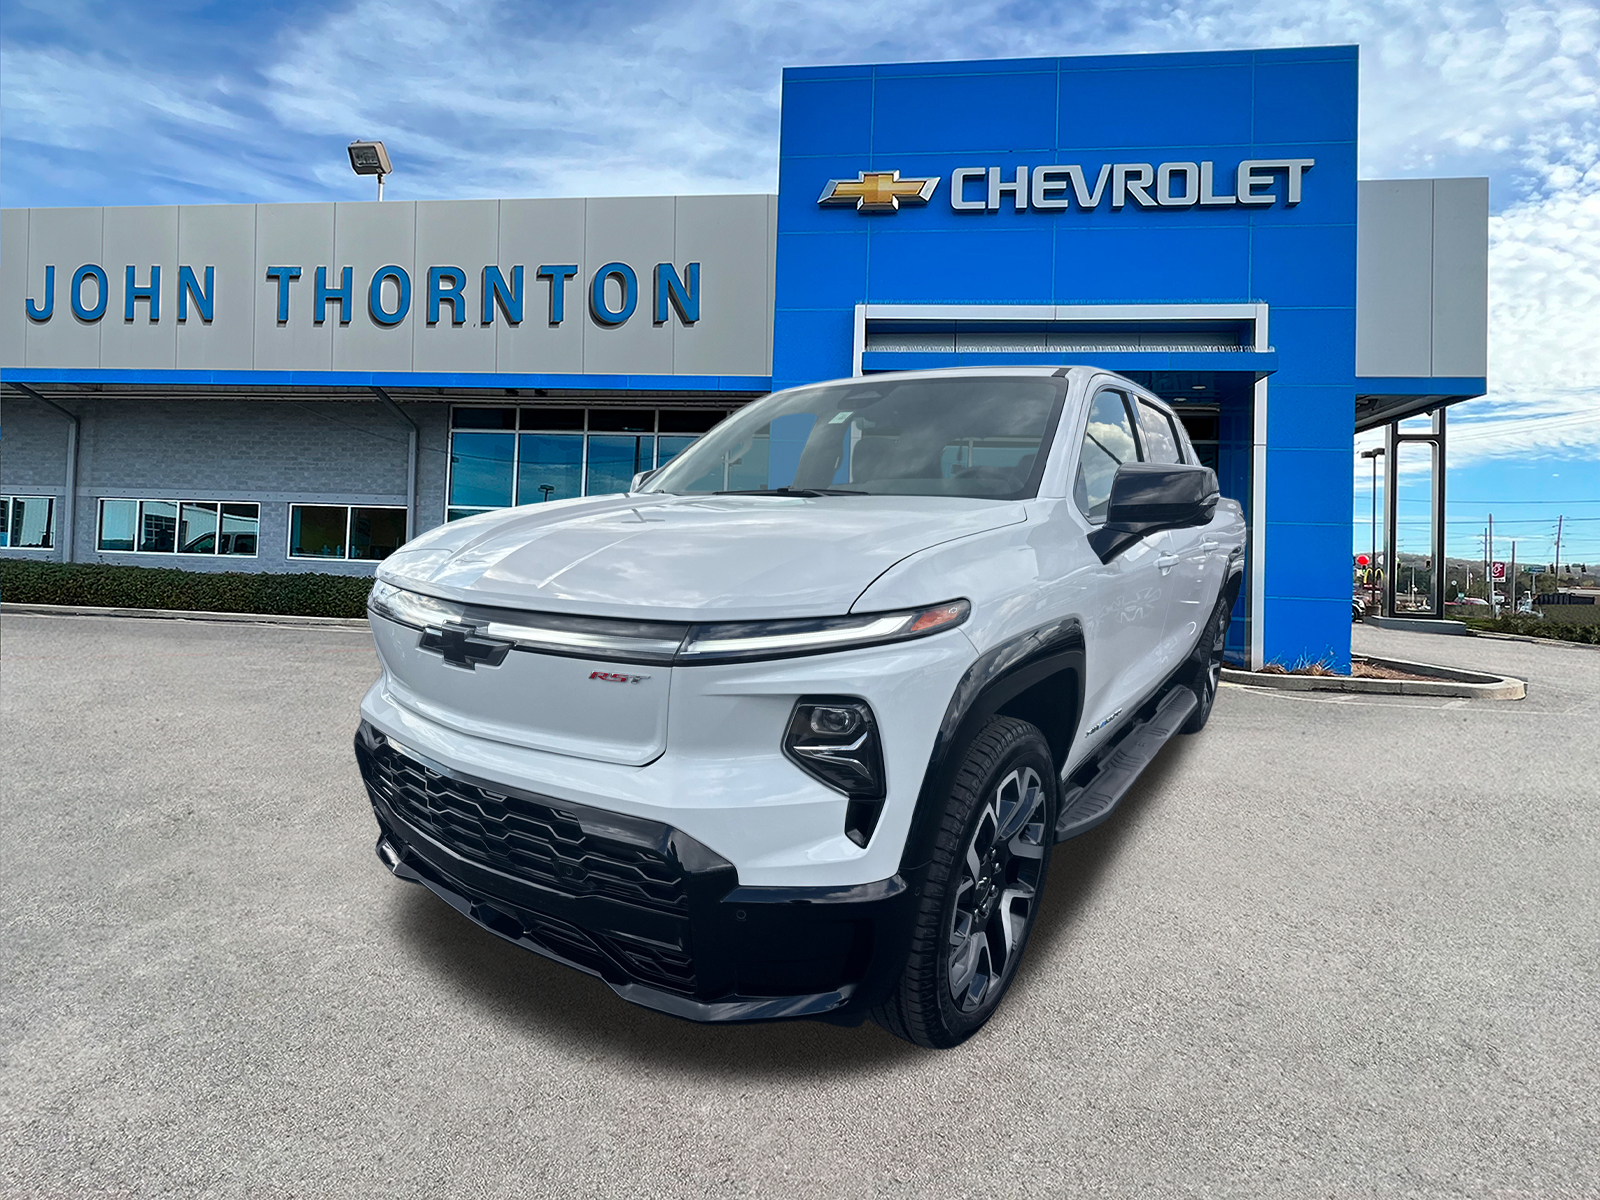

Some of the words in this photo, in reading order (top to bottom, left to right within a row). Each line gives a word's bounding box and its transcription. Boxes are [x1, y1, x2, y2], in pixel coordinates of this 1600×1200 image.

[952, 159, 1315, 210] CHEVROLET
[26, 265, 215, 323] JOHN
[267, 262, 701, 327] THORNTON
[589, 671, 651, 684] RST
